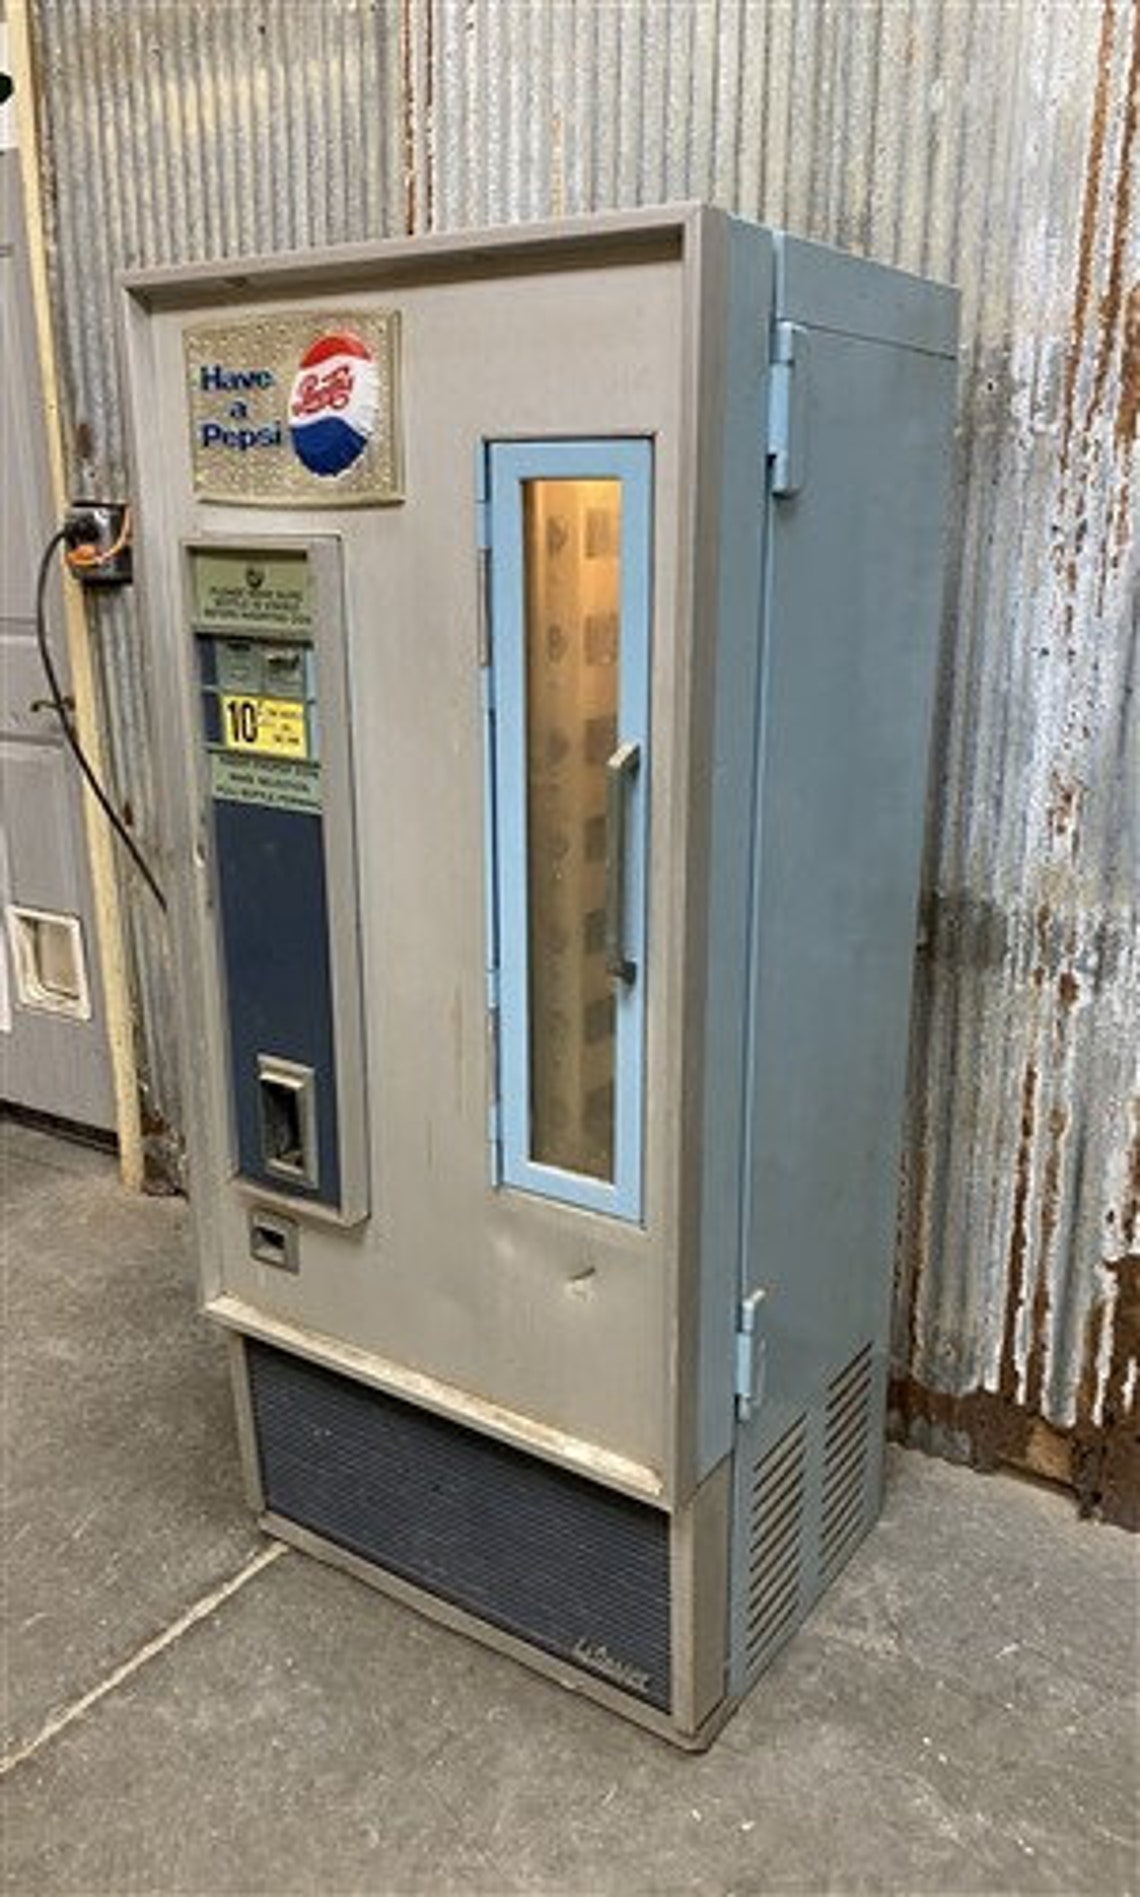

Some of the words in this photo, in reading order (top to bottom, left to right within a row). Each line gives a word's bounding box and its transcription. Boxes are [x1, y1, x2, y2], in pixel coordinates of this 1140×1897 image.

[201, 365, 274, 391] Have
[229, 401, 247, 419] a
[202, 420, 282, 450] Pepsi
